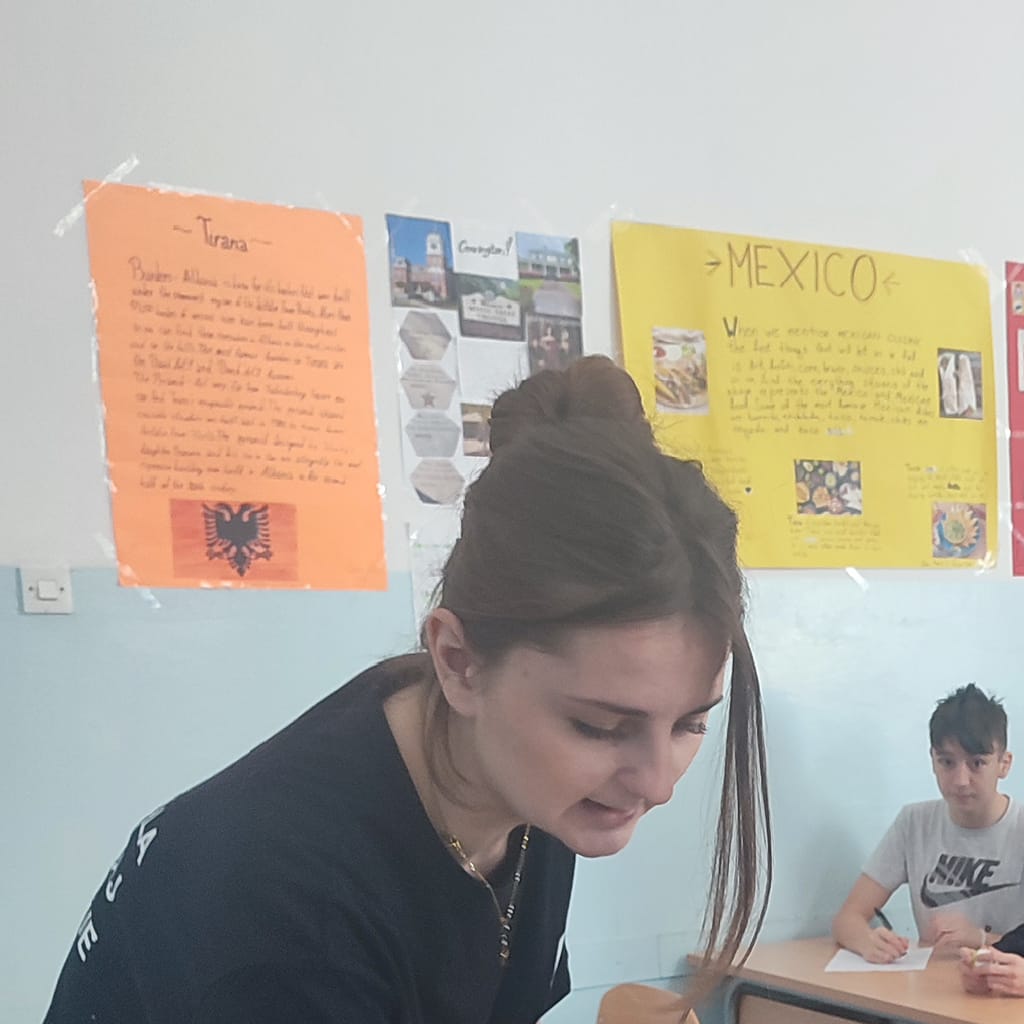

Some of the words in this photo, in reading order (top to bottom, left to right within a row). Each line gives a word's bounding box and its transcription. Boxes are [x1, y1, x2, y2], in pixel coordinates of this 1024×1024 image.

[196, 215, 249, 253] Tirana
[727, 241, 877, 302] MEXICO
[929, 853, 1001, 887] NIKE
